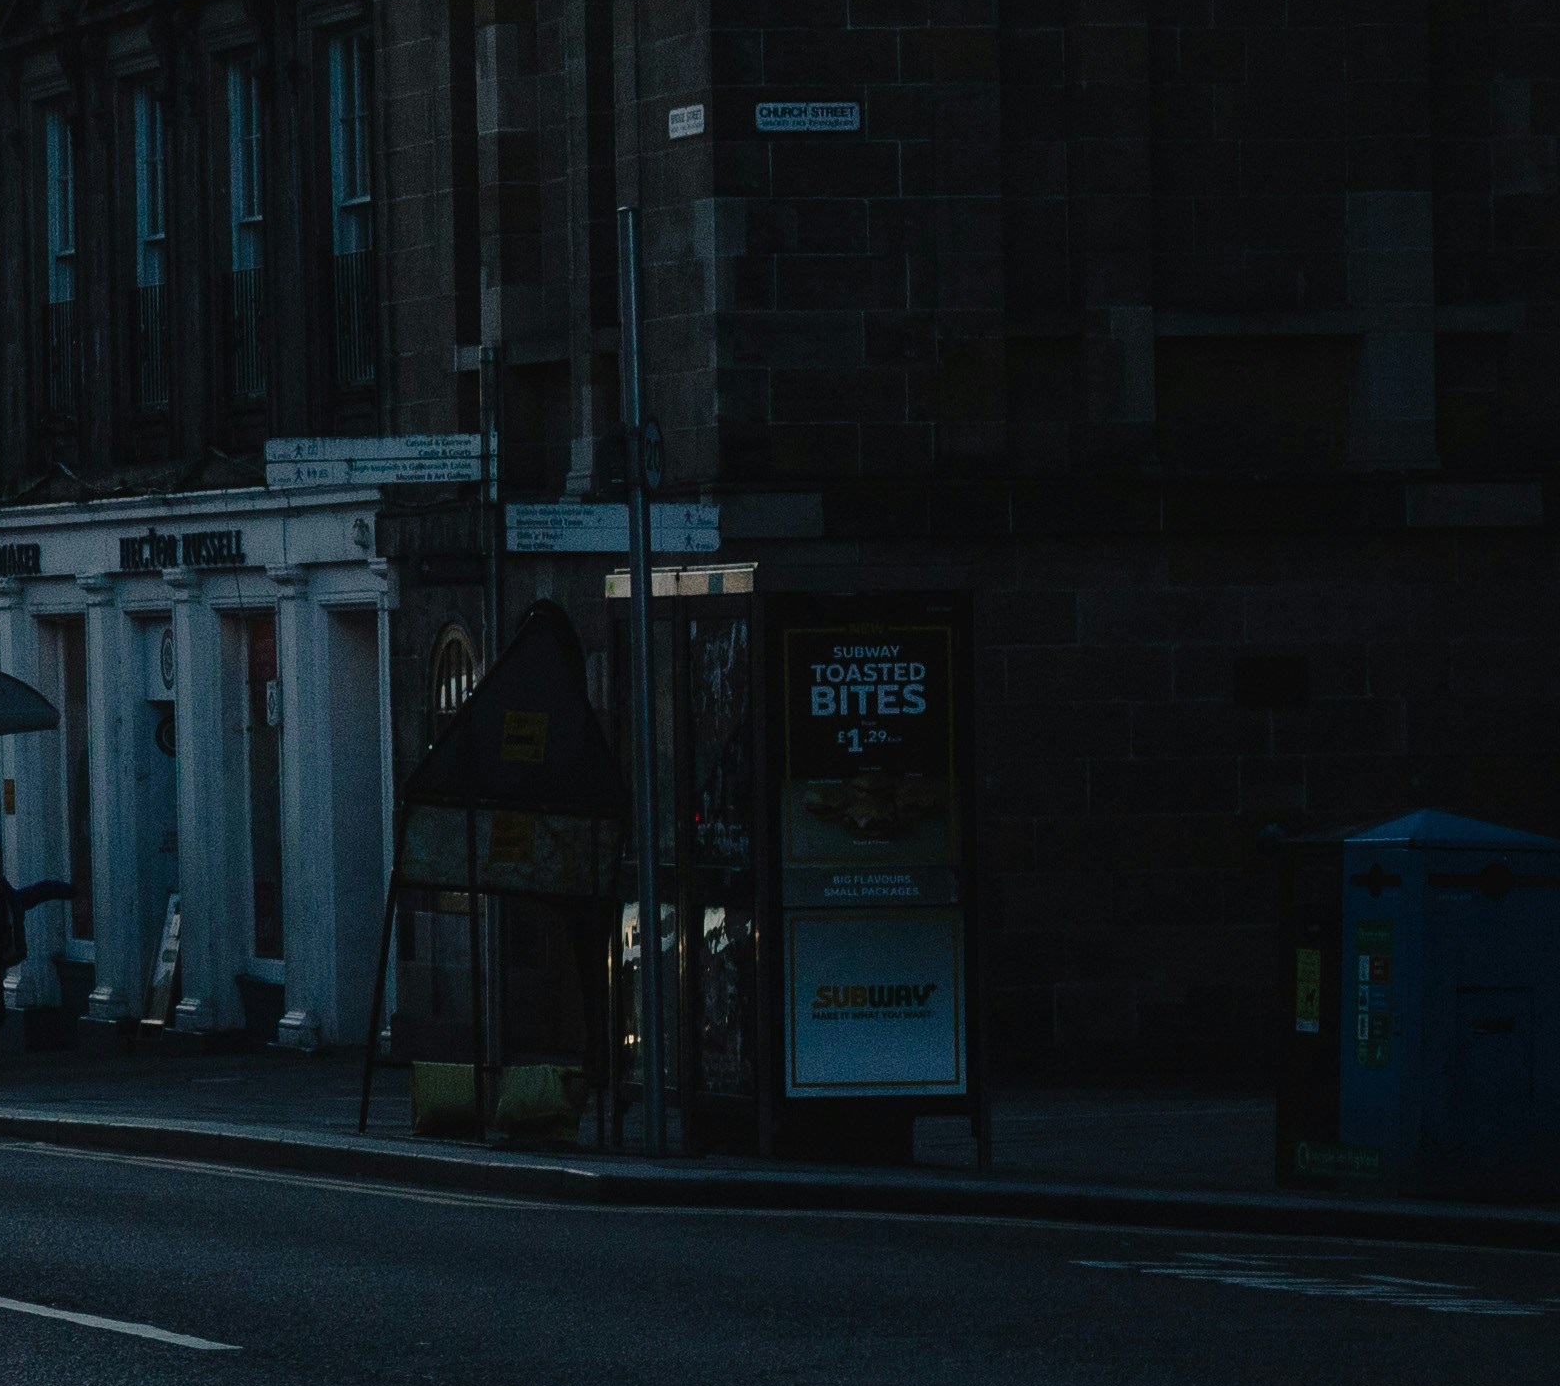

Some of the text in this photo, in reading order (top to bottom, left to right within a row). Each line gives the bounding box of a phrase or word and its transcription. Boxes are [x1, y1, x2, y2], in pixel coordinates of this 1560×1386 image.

[760, 106, 855, 118] CHURCH STREET
[418, 449, 440, 457] Castle
[646, 438, 660, 473] 20
[396, 473, 426, 481] Museum
[447, 471, 472, 480] Gallery
[120, 527, 245, 569] HECTOR RUSSELL
[849, 623, 886, 634] NEW
[833, 646, 902, 659] SUBWAY
[810, 662, 927, 684] TOASTED
[811, 683, 928, 717] BITES
[837, 728, 888, 754] £1.29
[833, 874, 852, 885] BIG
[823, 887, 859, 898] SMALL
[812, 984, 937, 1008] SUBWAY
[812, 1012, 838, 1020] MAKE
[881, 1011, 903, 1019] YOU
